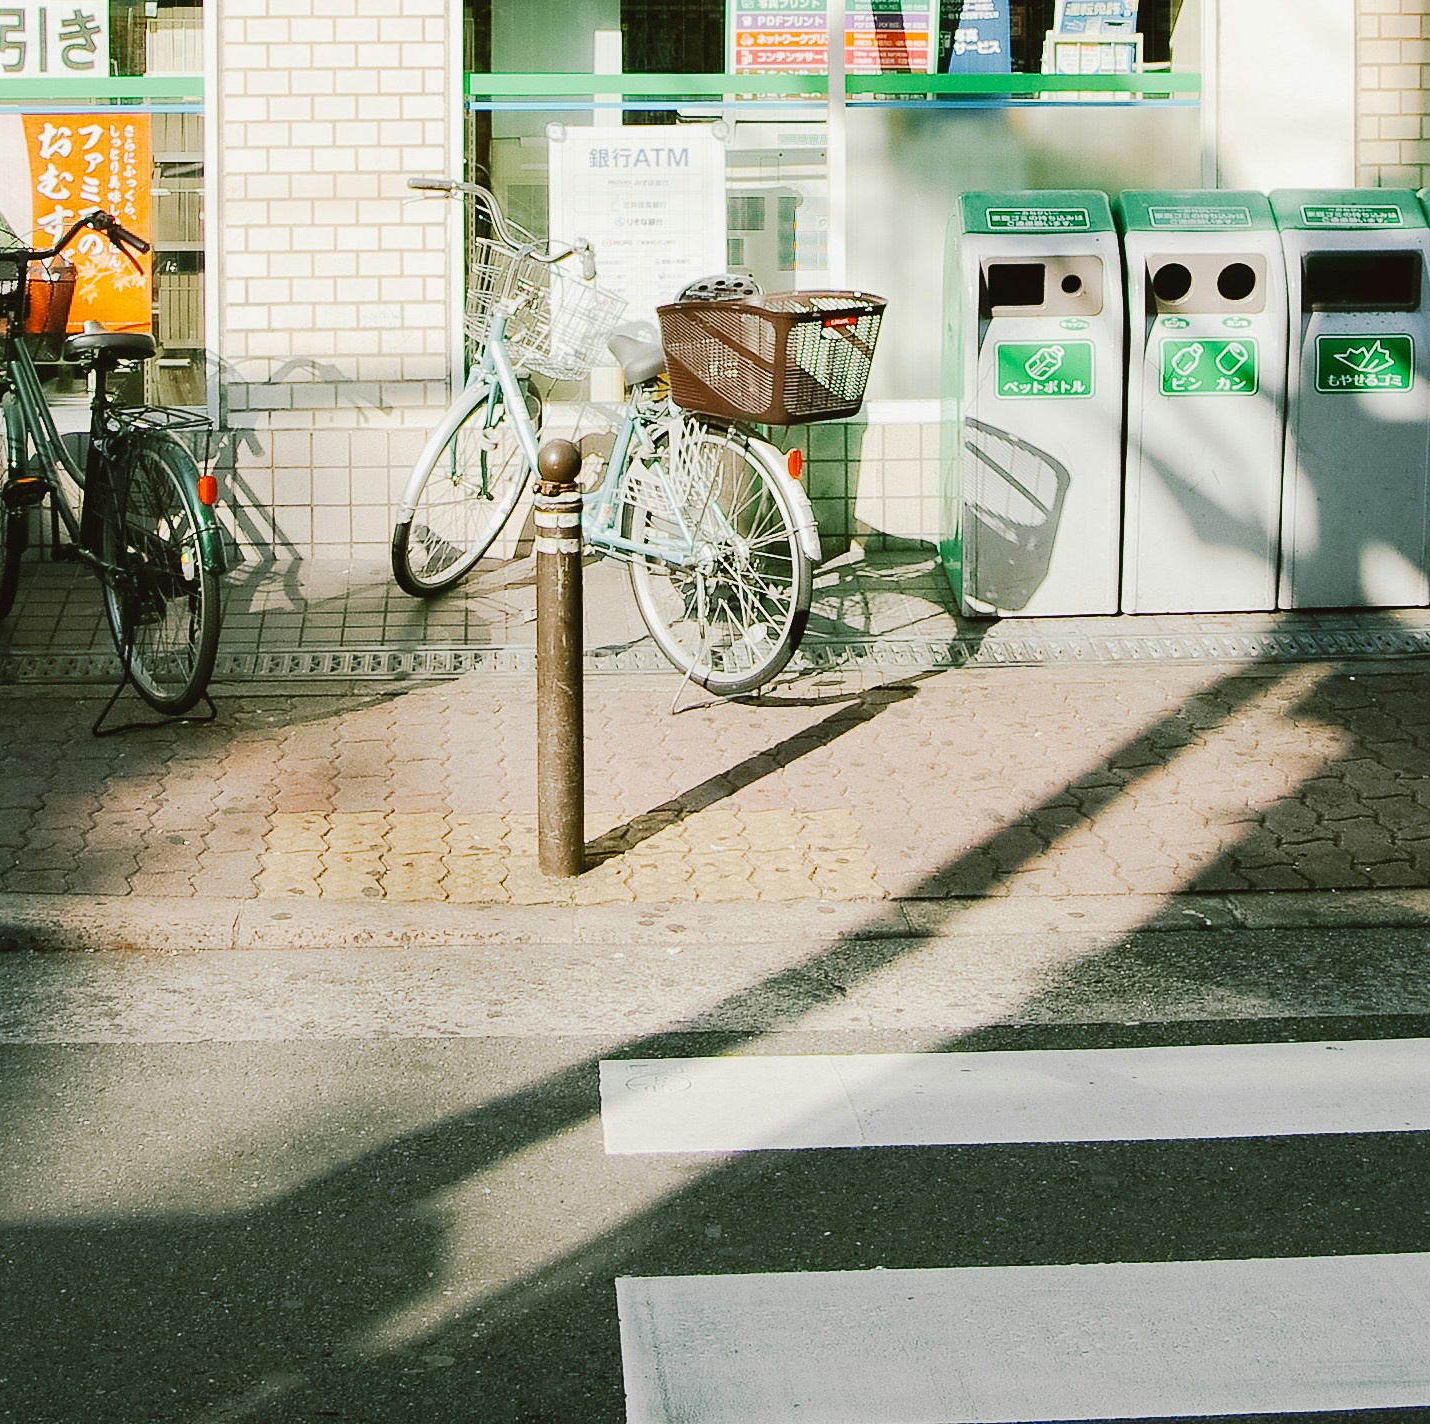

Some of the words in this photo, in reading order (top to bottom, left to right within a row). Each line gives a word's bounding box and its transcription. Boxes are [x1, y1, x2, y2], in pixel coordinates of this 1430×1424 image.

[757, 15, 824, 28] PDFプリント
[589, 147, 690, 169] 銀行ATM
[122, 124, 138, 221] さらにふっくら、
[626, 216, 663, 226] りそな銀行
[1002, 379, 1088, 394] ペットボトル
[1171, 376, 1203, 391] ビン
[1215, 376, 1247, 391] カン
[1328, 373, 1403, 387] もやせるゴミ
